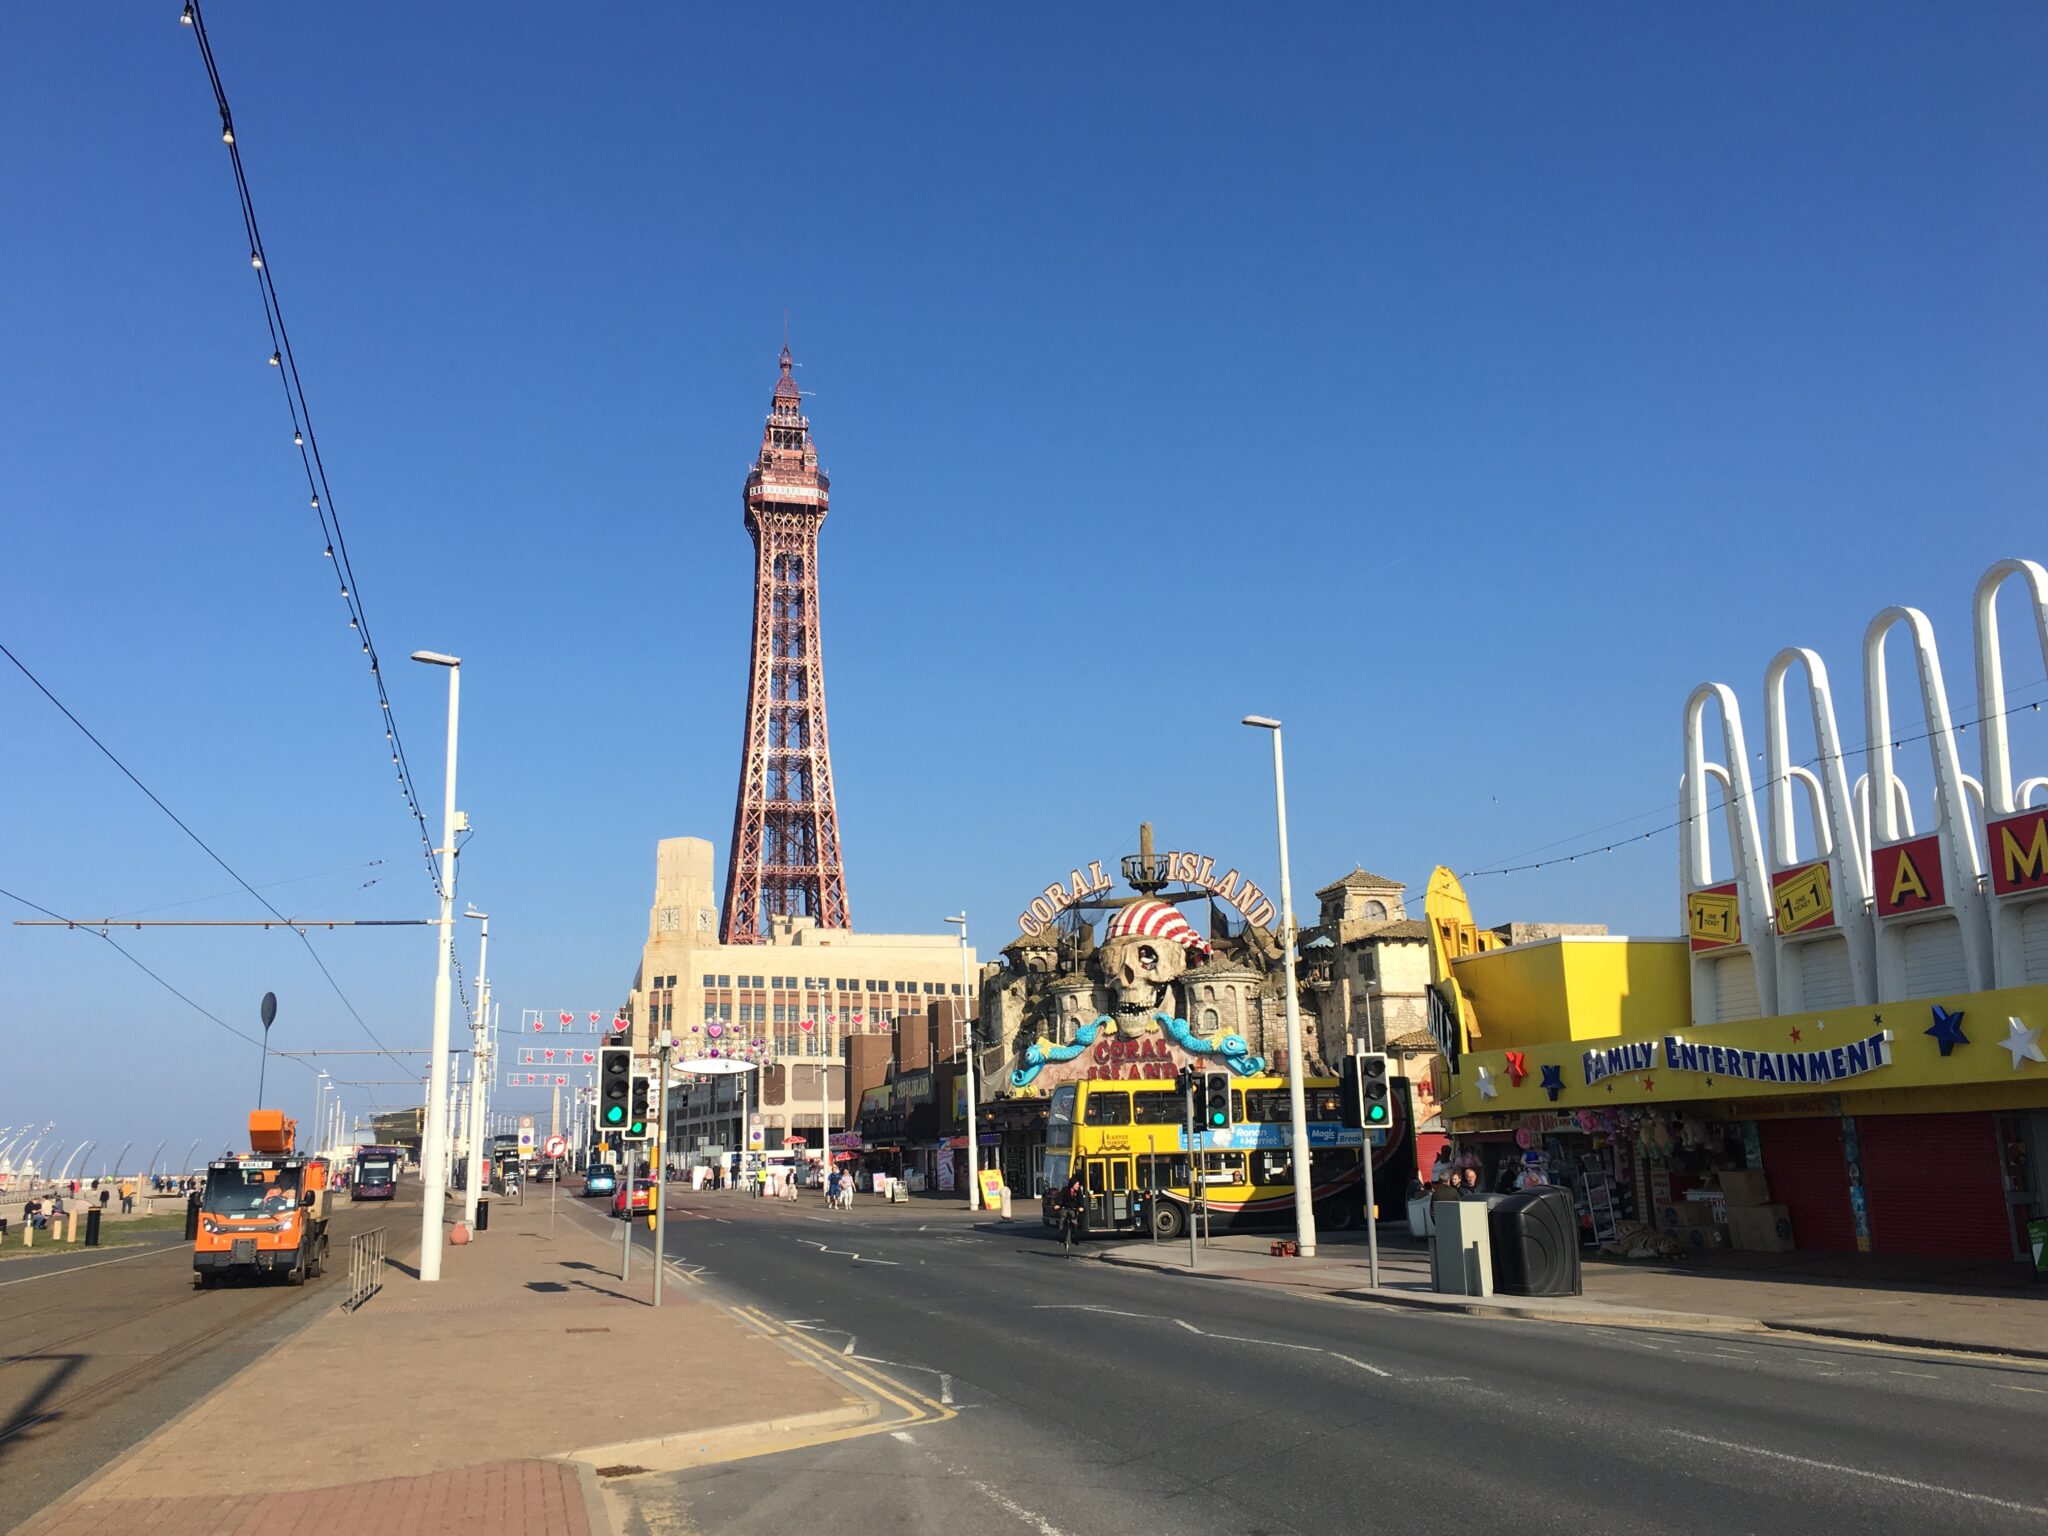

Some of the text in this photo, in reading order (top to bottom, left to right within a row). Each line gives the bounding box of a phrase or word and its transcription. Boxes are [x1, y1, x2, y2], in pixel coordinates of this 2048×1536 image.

[1019, 851, 1276, 937] CORAL ISLAND
[1094, 1039, 1173, 1064] CORAL
[1582, 1029, 1895, 1087] FAMILY ENTERTAINMENT
[1088, 1063, 1179, 1080] ISLAND
[1236, 1128, 1267, 1138] Ronan
[1244, 1136, 1278, 1145] Harriet
